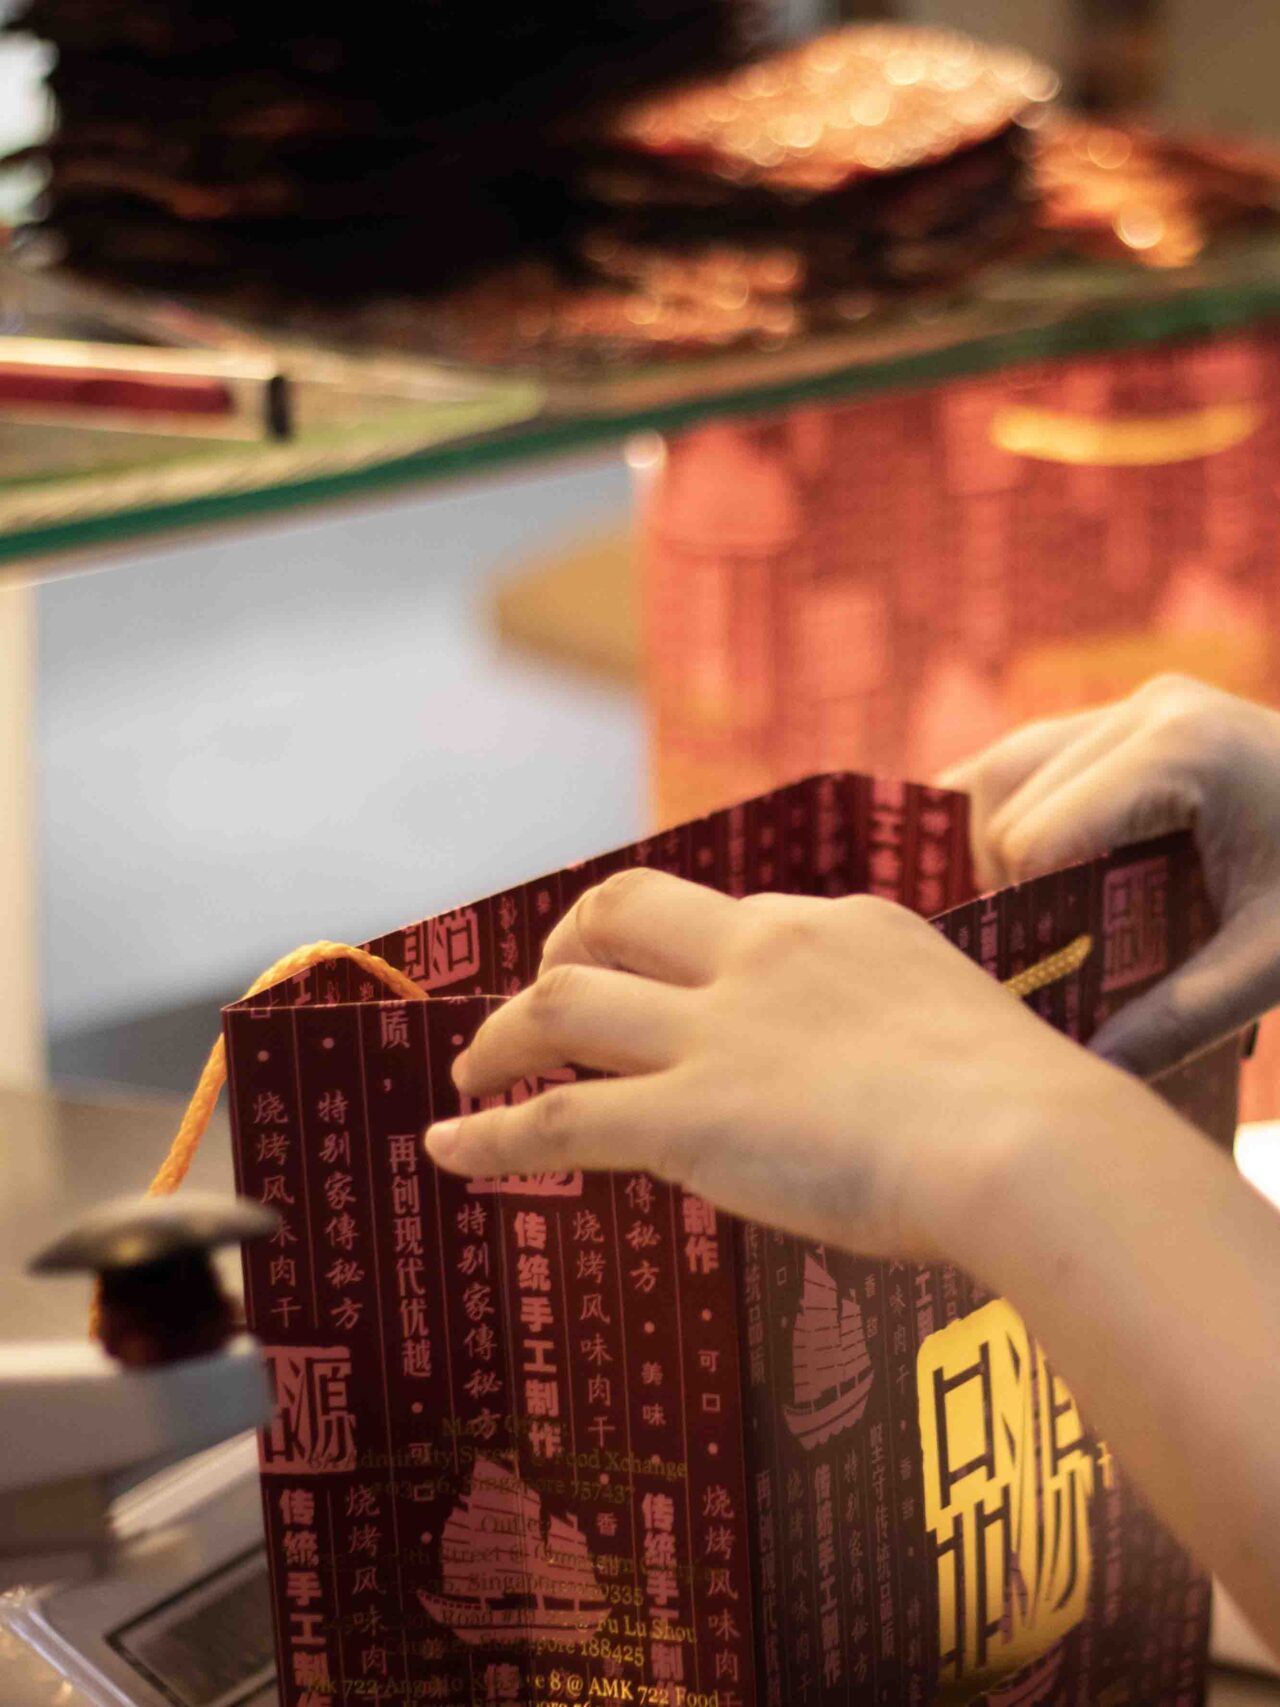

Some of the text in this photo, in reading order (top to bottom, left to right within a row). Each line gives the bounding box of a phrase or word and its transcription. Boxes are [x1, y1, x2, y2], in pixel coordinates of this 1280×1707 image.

[572, 1209, 616, 1447] 烧烤风味肉干
[641, 1360, 667, 1427] 美味
[698, 1349, 721, 1411] 可口
[580, 1637, 646, 1667] 188425
[624, 1615, 647, 1639] Lu
[652, 1618, 698, 1643] Shou
[550, 1669, 561, 1691] 8
[567, 1673, 584, 1695] @
[589, 1676, 635, 1701] AMK
[638, 1686, 670, 1705] 722
[675, 1685, 719, 1707] Food
